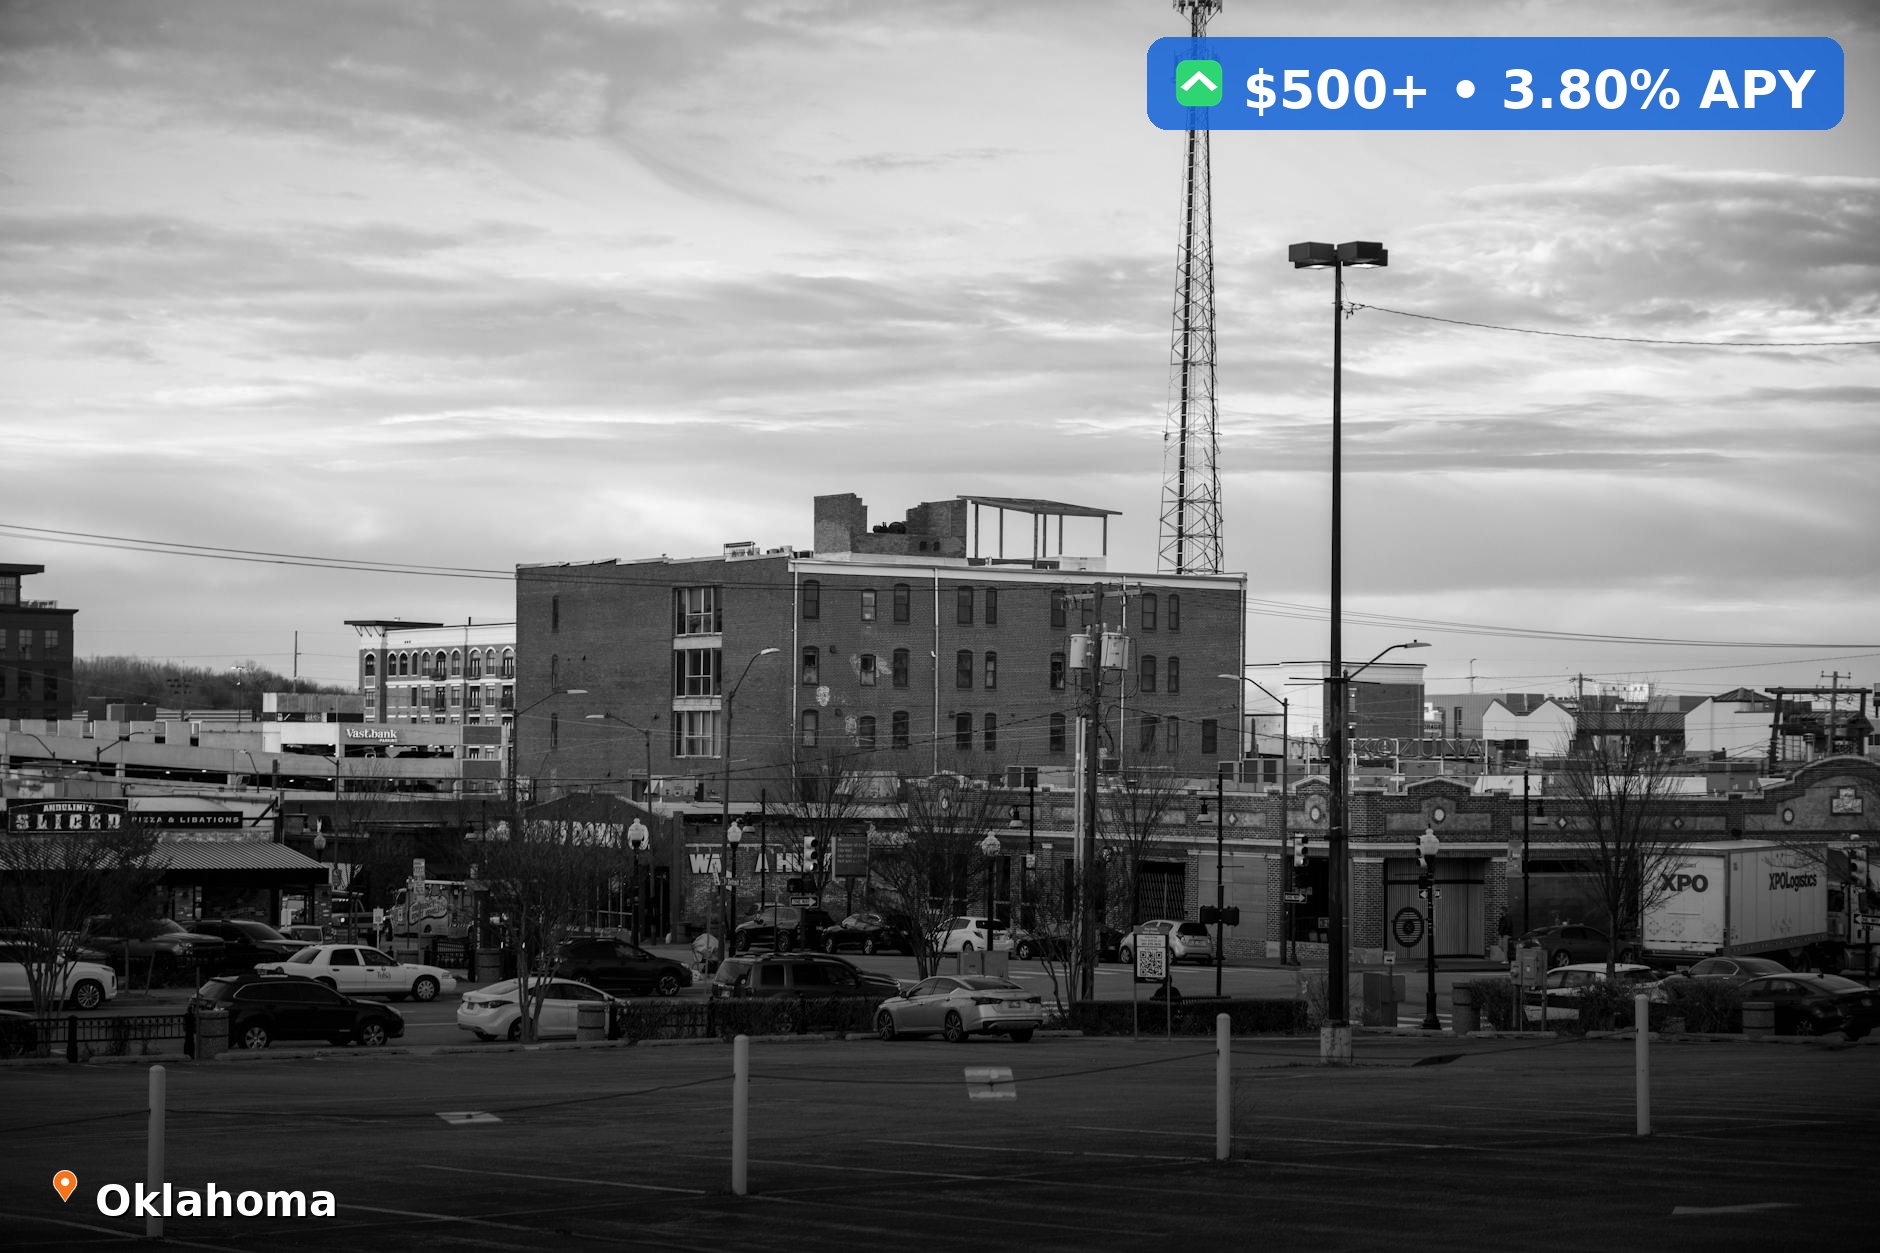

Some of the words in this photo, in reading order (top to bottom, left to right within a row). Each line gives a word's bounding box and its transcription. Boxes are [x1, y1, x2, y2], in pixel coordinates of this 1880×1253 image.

[1311, 738, 1486, 760] YKOZUNA
[43, 803, 95, 813] ANDOLINI'S
[16, 813, 122, 831] SLICED
[131, 816, 163, 824] PIZZA
[167, 816, 175, 824] &
[179, 816, 239, 824] LIBATIONS
[1660, 873, 1708, 893] XPO
